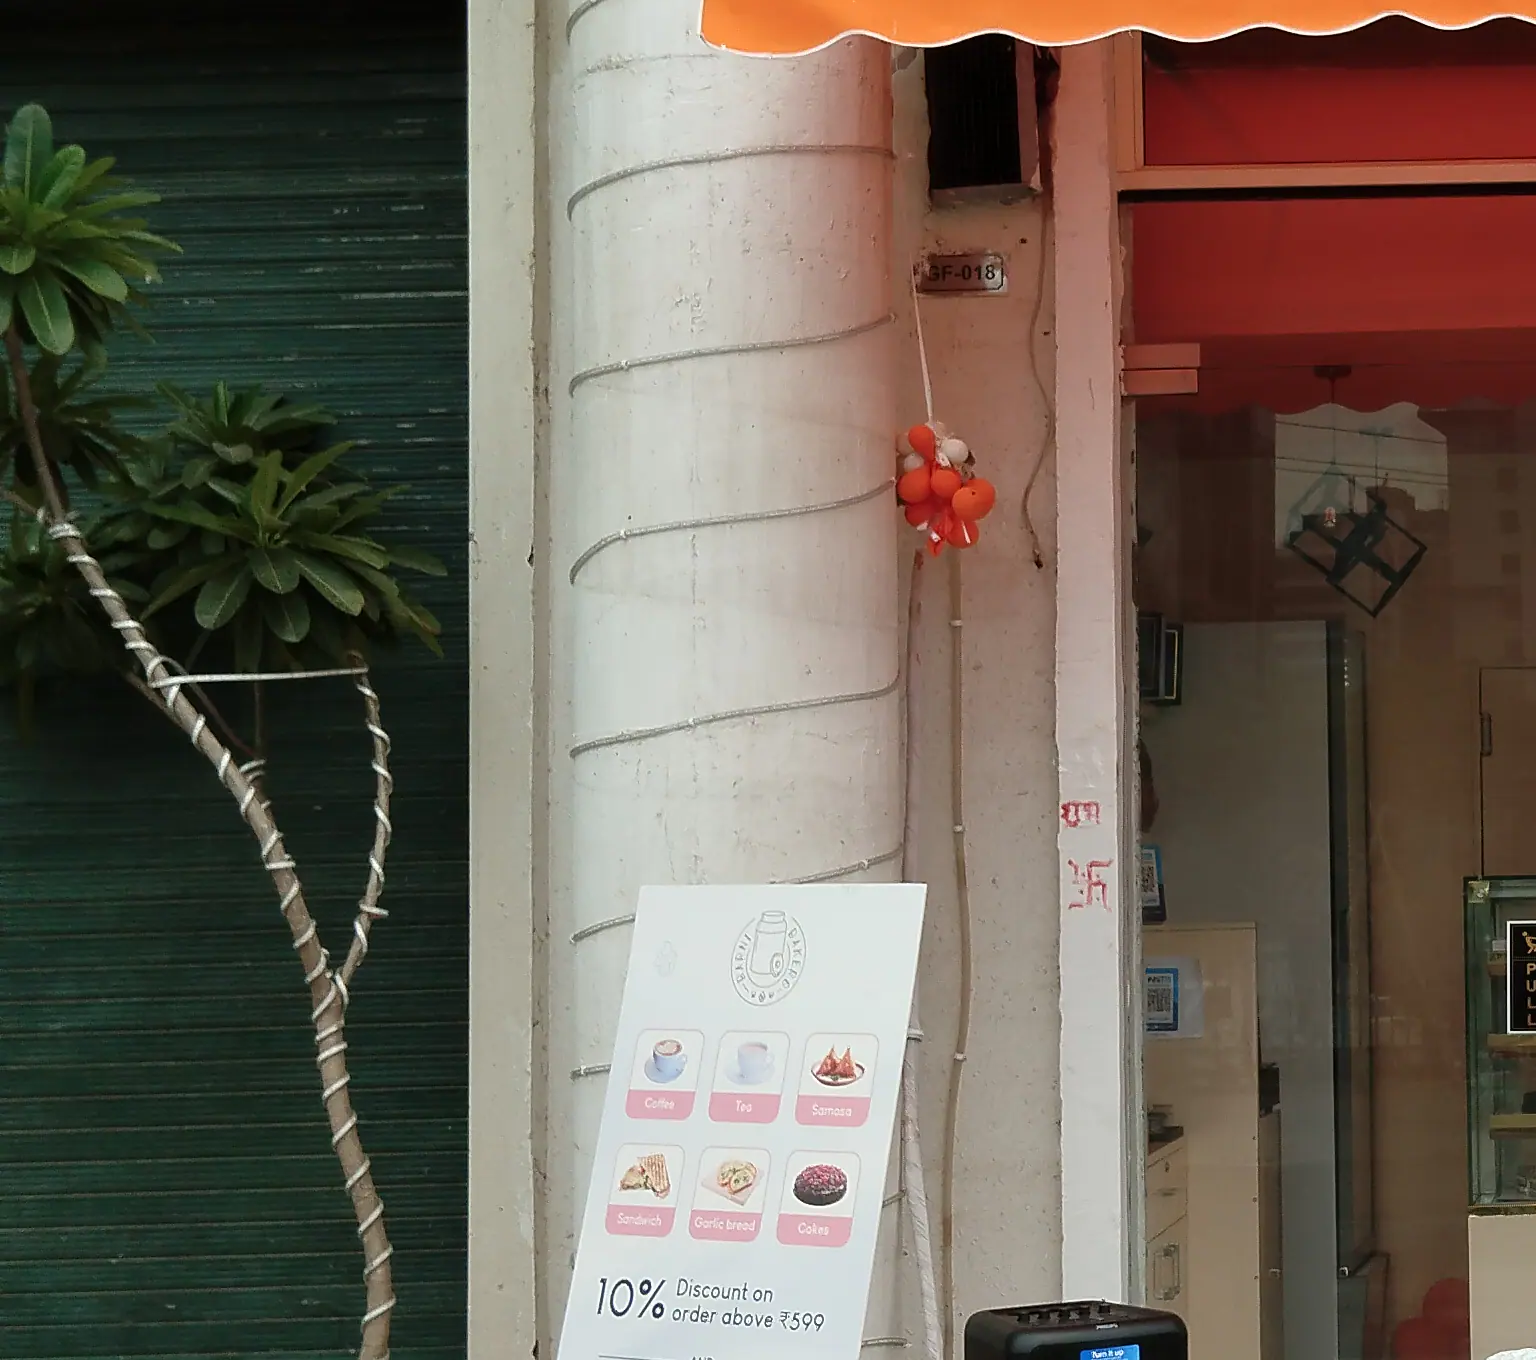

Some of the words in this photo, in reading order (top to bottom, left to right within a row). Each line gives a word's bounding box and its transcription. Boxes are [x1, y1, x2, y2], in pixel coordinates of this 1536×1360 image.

[928, 264, 996, 282] GF-018
[1525, 962, 1536, 1026] PULL
[644, 1097, 675, 1110] Coffee
[735, 1100, 752, 1113] Tea
[812, 1104, 852, 1117] Samosa
[617, 1212, 662, 1227] Sandwich
[694, 1216, 724, 1230] Garlic
[726, 1219, 755, 1232] bread
[798, 1223, 829, 1237] Cakes
[597, 1278, 666, 1319] 10%
[676, 1278, 748, 1302] Discount
[753, 1290, 773, 1303] on
[672, 1305, 717, 1324] order
[722, 1308, 773, 1328] above
[779, 1311, 824, 1332] ₹599
